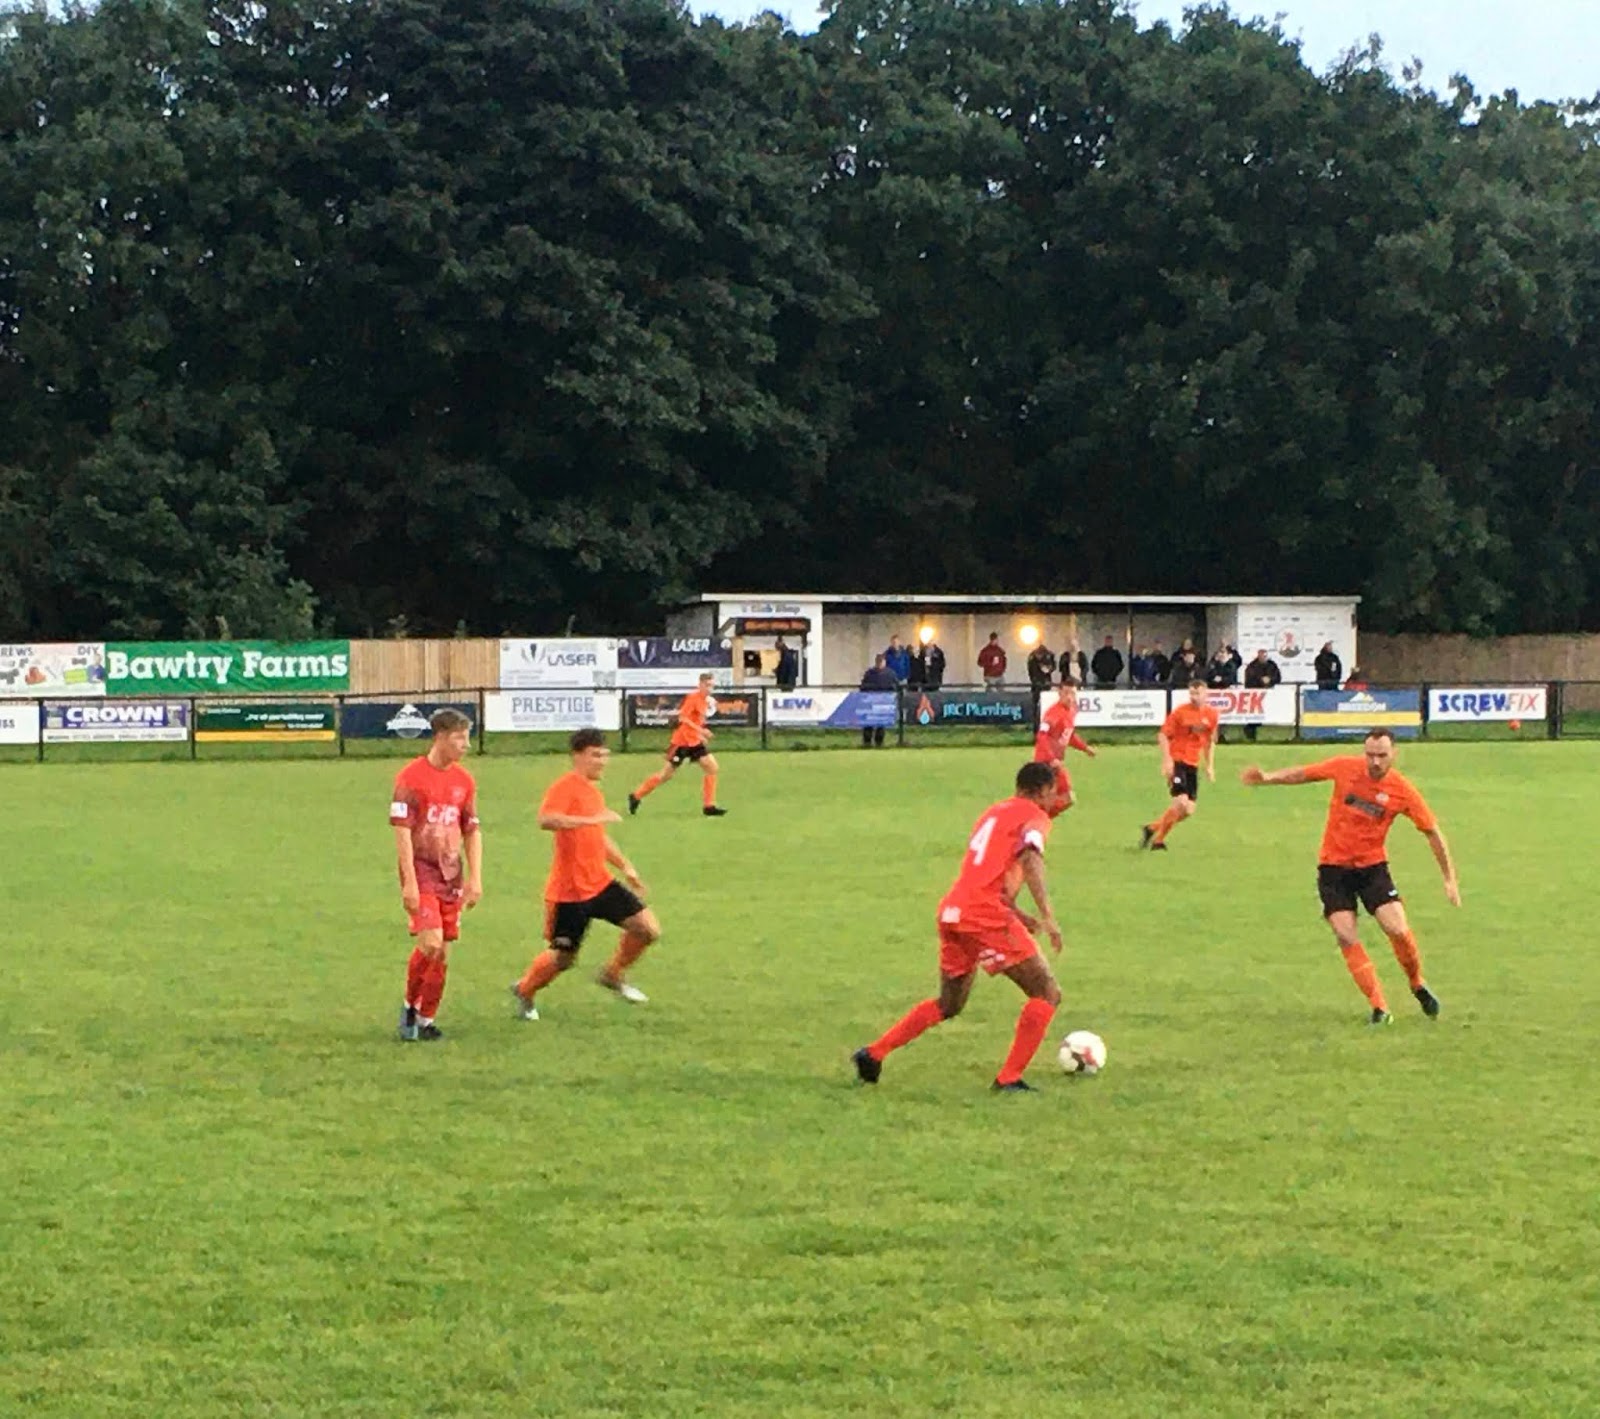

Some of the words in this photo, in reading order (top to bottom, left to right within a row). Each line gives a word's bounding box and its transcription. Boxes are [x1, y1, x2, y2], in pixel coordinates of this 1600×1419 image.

[672, 639, 710, 652] LASER
[107, 651, 232, 684] Bawtry
[242, 651, 348, 678] Farms
[547, 653, 597, 666] LASER
[511, 696, 594, 713] PRESTIGE
[1438, 693, 1540, 716] SCREWFIX
[66, 706, 164, 722] CROWN
[969, 816, 997, 866] 4
